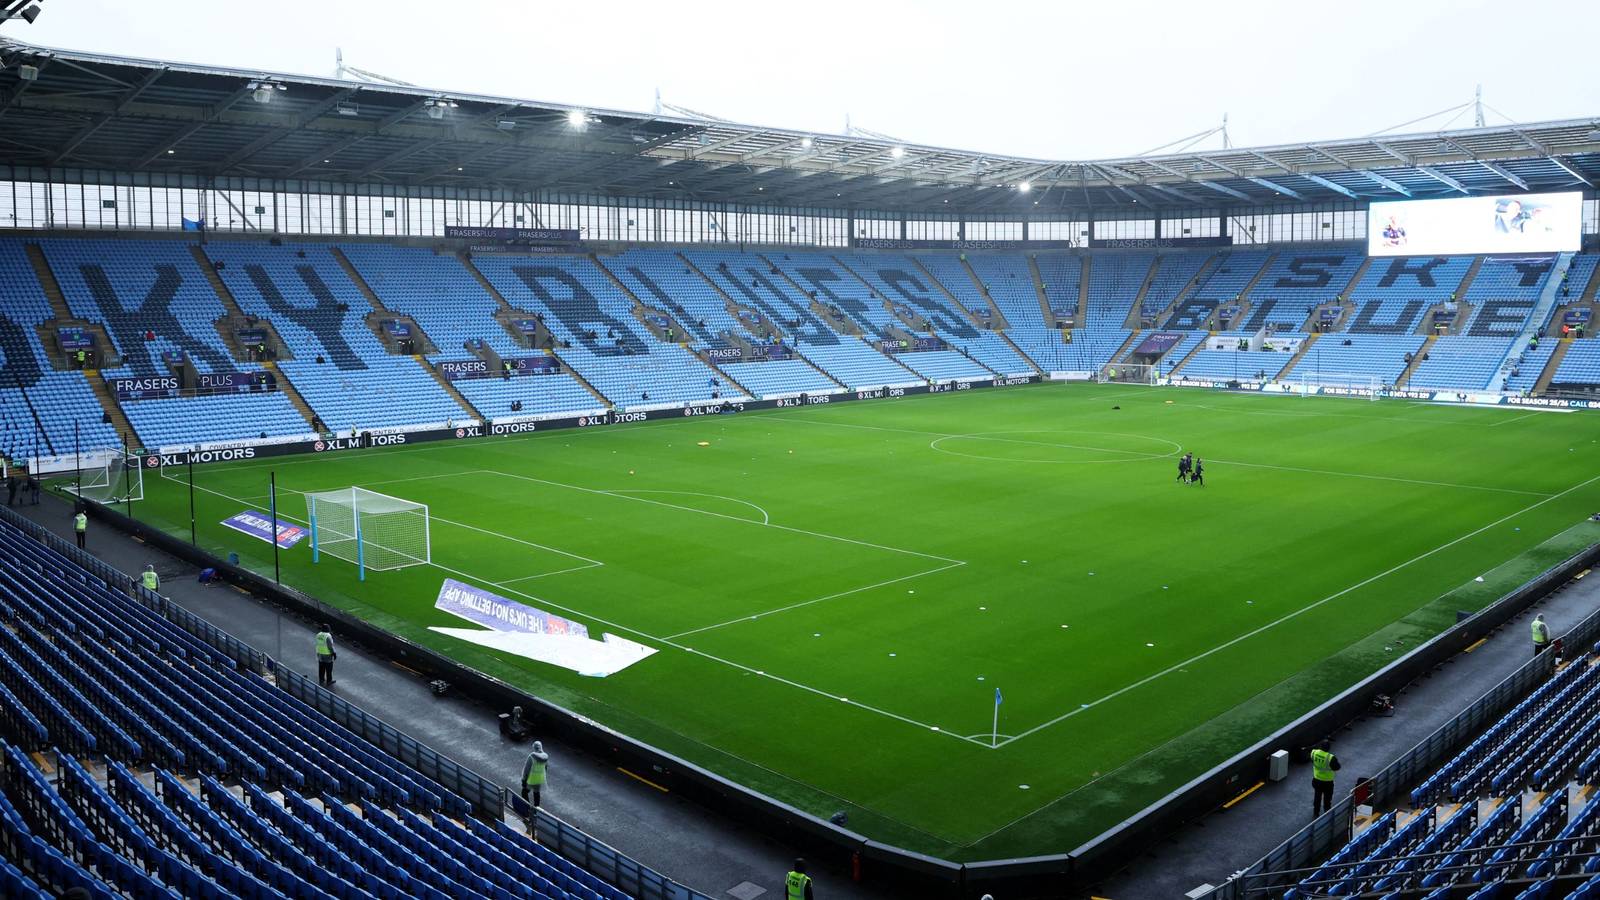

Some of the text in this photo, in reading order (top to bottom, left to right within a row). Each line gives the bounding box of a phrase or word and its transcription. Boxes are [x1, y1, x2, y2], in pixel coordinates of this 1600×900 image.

[709, 348, 742, 358] FRASERS
[442, 361, 487, 373] FRASERS
[116, 375, 233, 392] FRASERS PLUS
[1006, 377, 1030, 385] MOTORS
[1570, 400, 1587, 408] CALL
[692, 407, 704, 416] XL
[587, 416, 602, 426] XL
[467, 427, 482, 437] XL
[326, 434, 406, 451] XL MTORS
[162, 454, 183, 466] XL
[187, 447, 255, 464] MOTORS
[444, 586, 461, 601] APP
[459, 592, 490, 614] BETTING
[508, 608, 529, 628] UK'S
[528, 613, 543, 633] THE
